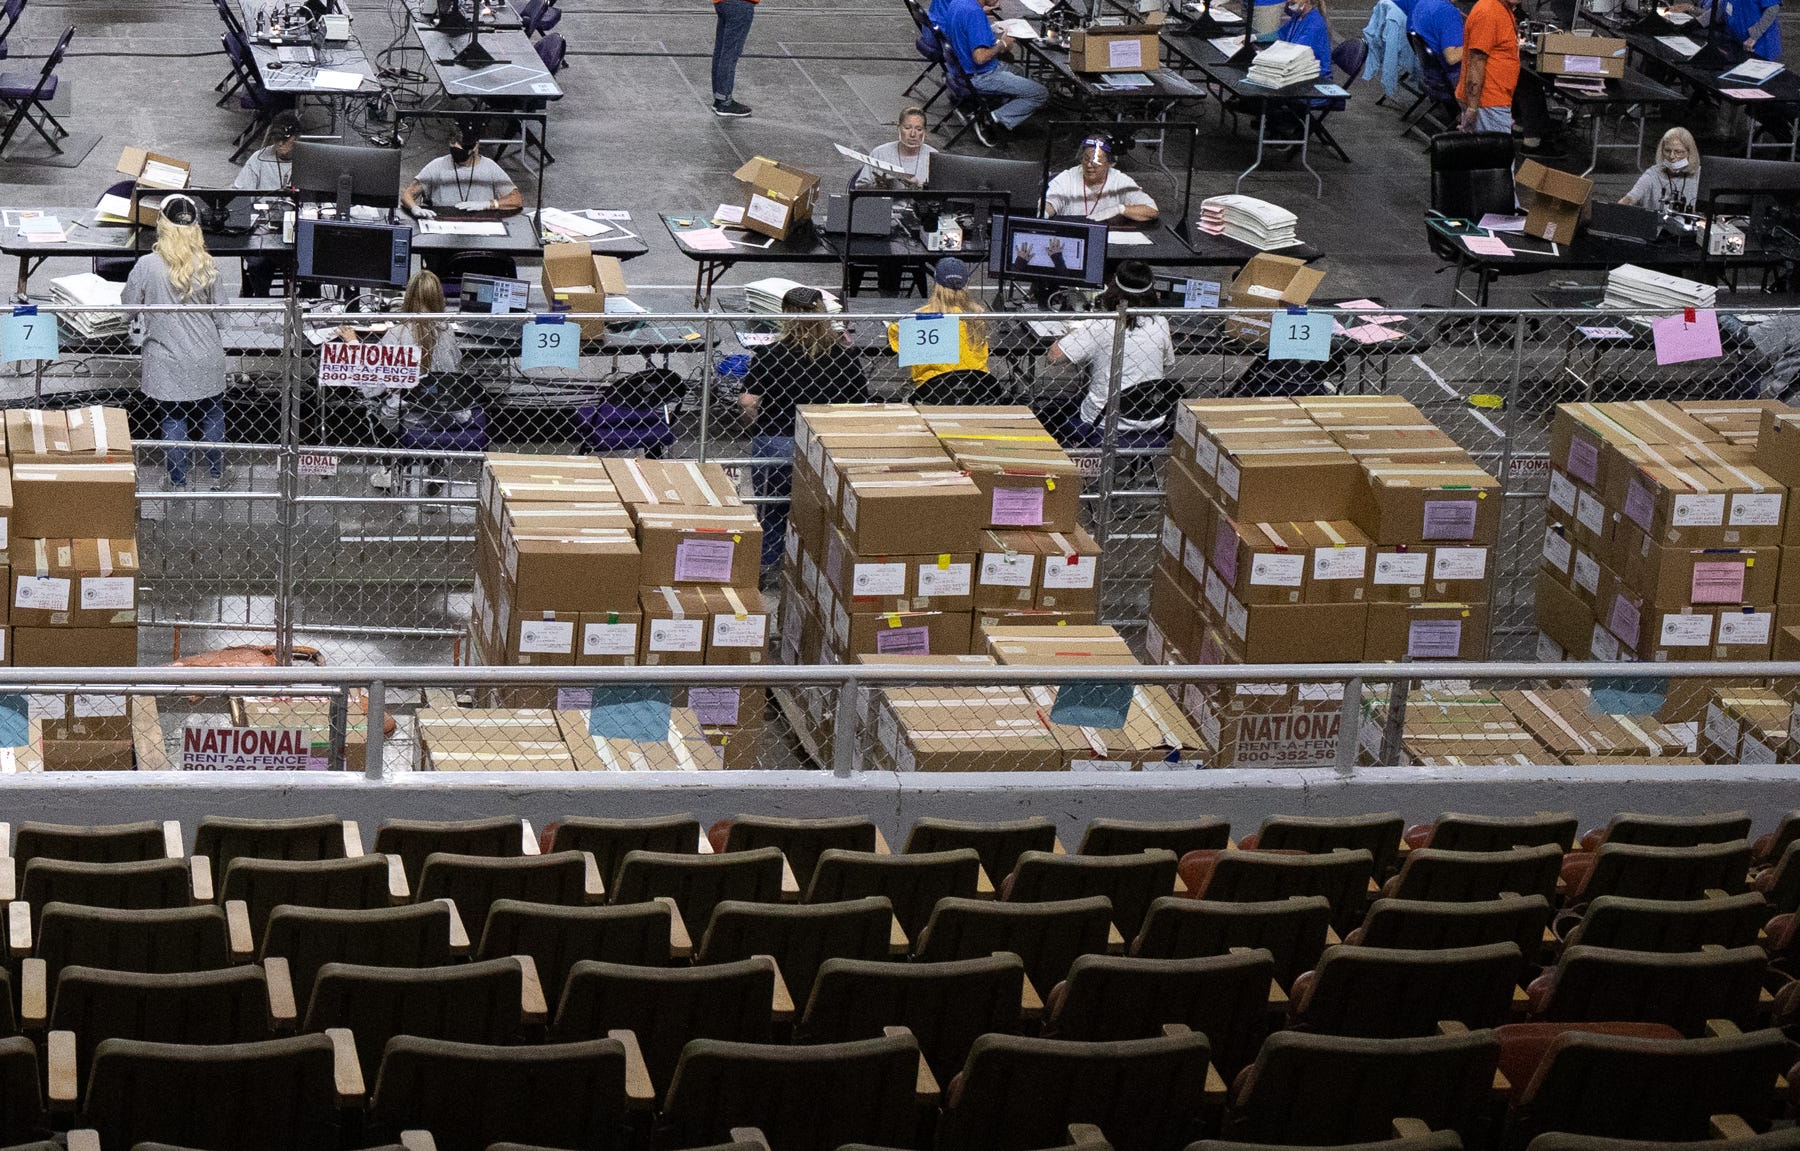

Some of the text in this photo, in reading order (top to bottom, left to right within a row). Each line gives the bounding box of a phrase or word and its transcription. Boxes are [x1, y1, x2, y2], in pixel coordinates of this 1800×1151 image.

[22, 325, 34, 340] 7
[1288, 324, 1310, 340] 13
[1683, 323, 1688, 331] 1
[537, 333, 561, 348] 39
[916, 329, 939, 345] 36
[324, 343, 417, 367] NATIONAL
[323, 364, 417, 375] RENT-A-FENCE
[322, 373, 416, 383] 800-352-5675
[302, 456, 334, 466] IONAL
[1239, 715, 1340, 741] NATIONA
[184, 728, 308, 755] NATIONAL
[1238, 740, 1338, 751] RENT-A-FEN
[184, 753, 307, 765] RENT-A-FENCE
[1237, 750, 1336, 762] 800-352-56
